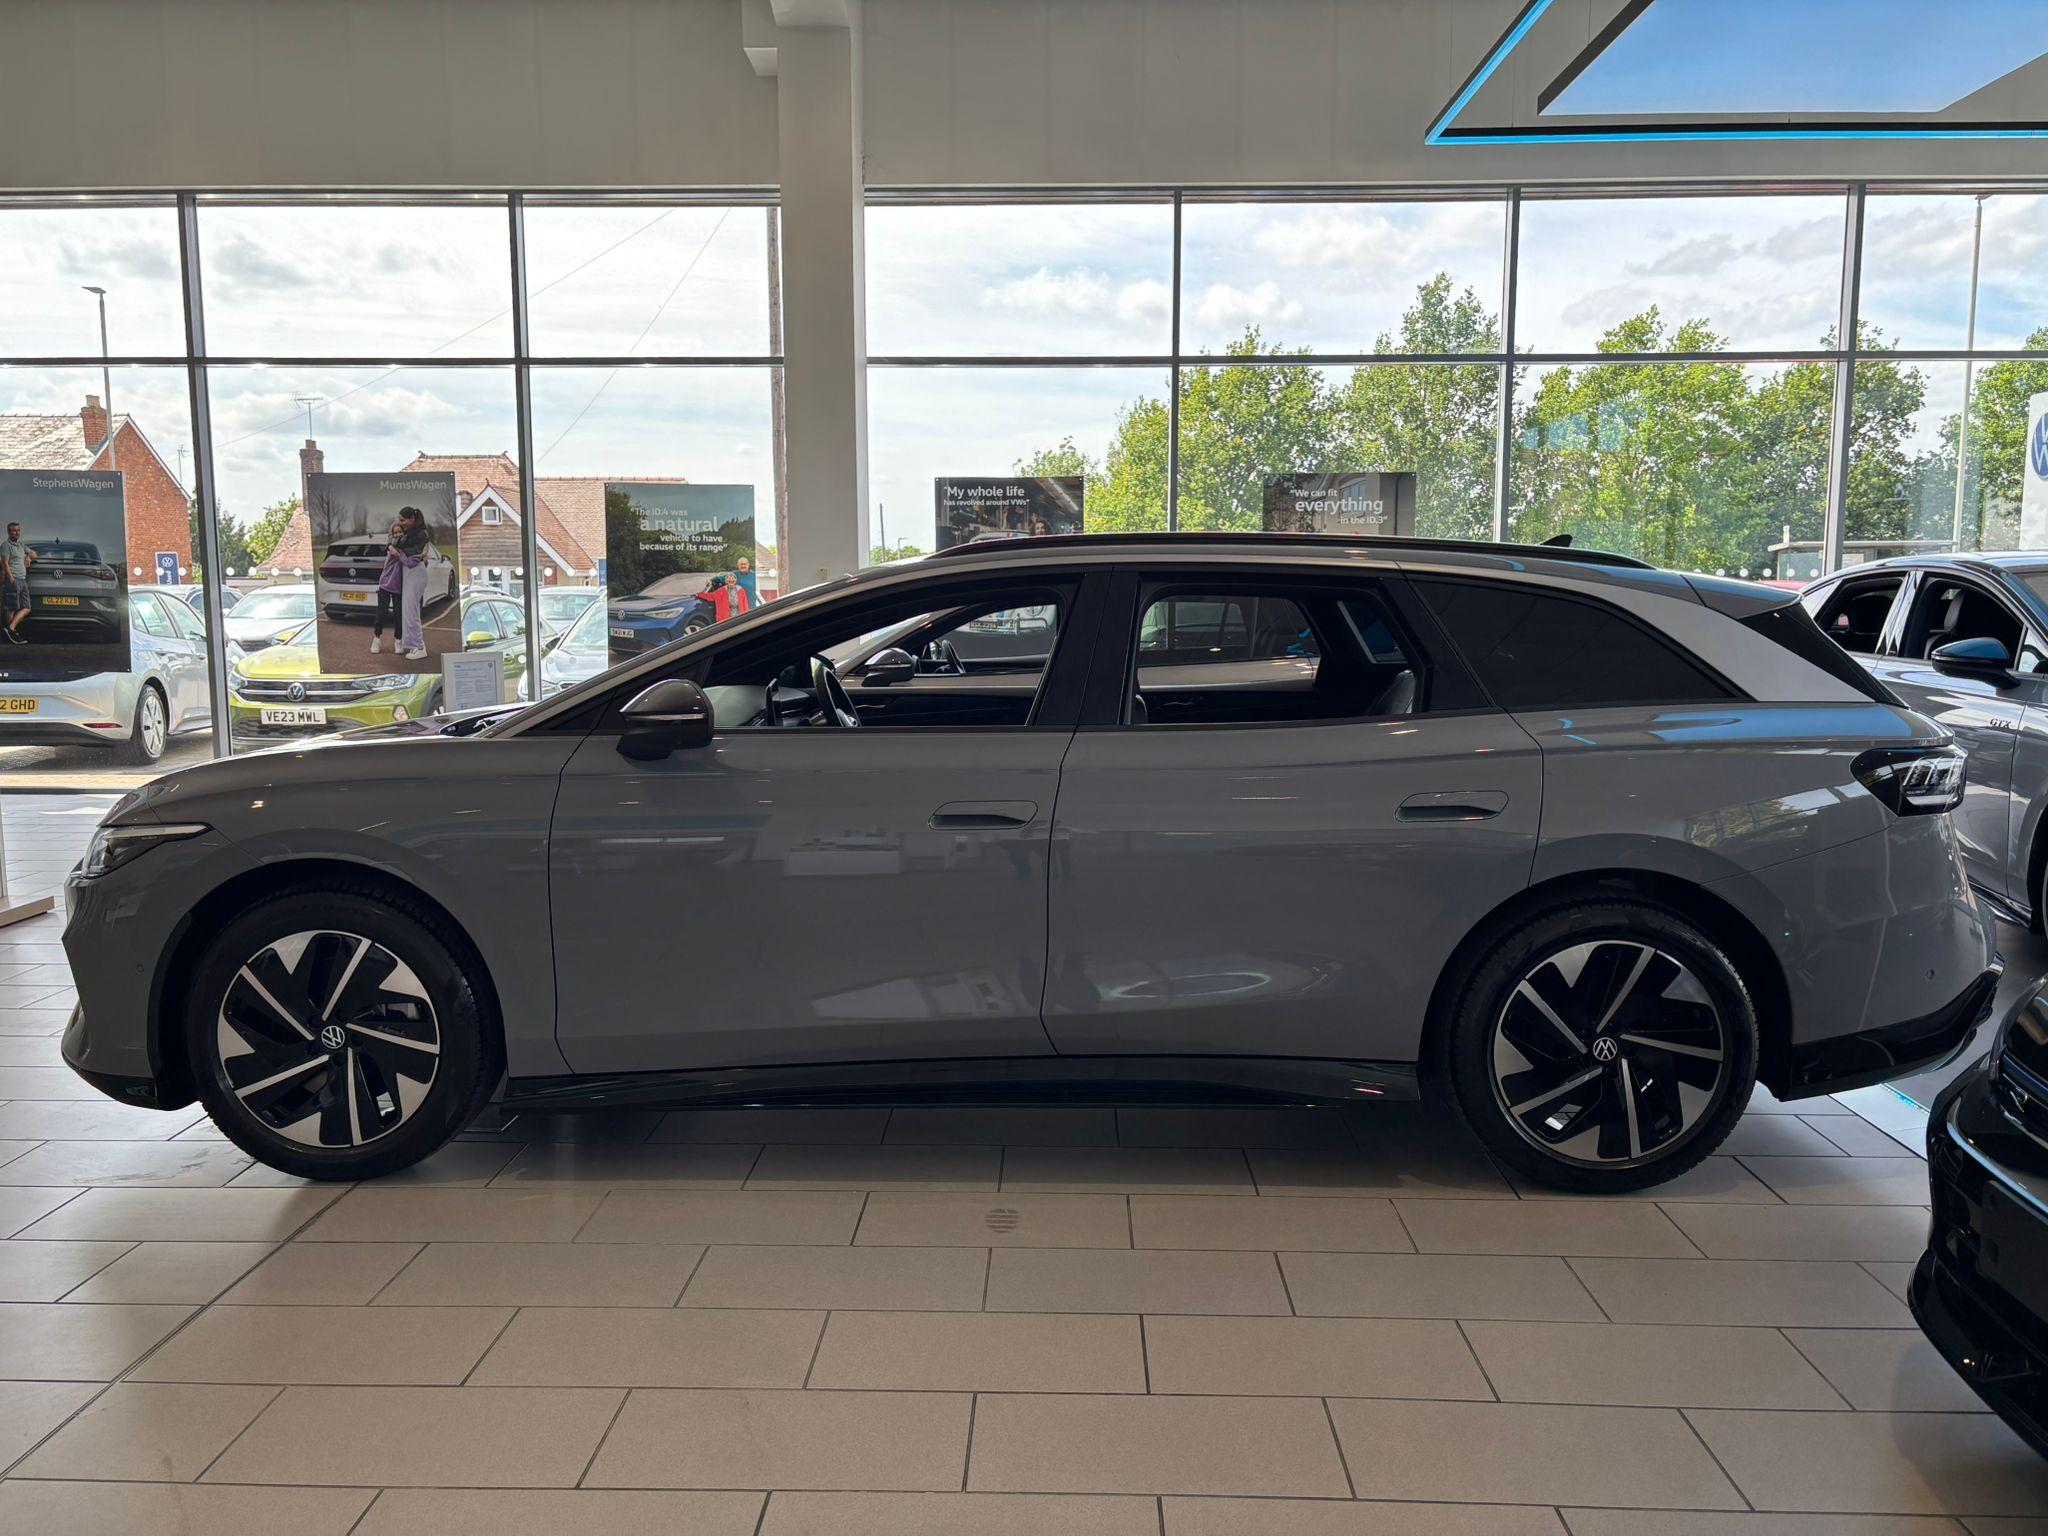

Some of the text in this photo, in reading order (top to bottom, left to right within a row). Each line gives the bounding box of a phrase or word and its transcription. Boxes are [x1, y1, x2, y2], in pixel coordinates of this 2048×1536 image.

[32, 477, 114, 491] StephensWagen
[380, 479, 447, 491] MumsWagen
[967, 486, 1004, 497] whole
[1006, 485, 1025, 497] life
[1311, 490, 1326, 498] can
[1327, 488, 1338, 497] fit
[652, 507, 669, 516] ID.4
[1295, 497, 1383, 515] everything
[640, 516, 719, 532] a natural
[1340, 516, 1348, 525] in
[1350, 516, 1365, 525] the
[660, 534, 724, 543] vehicle to have
[640, 542, 674, 551] because
[675, 542, 685, 551] of
[686, 543, 698, 551] its
[11, 699, 36, 710] GHD
[266, 711, 321, 722] VE23 MWL
[1990, 718, 2012, 729] GTX
